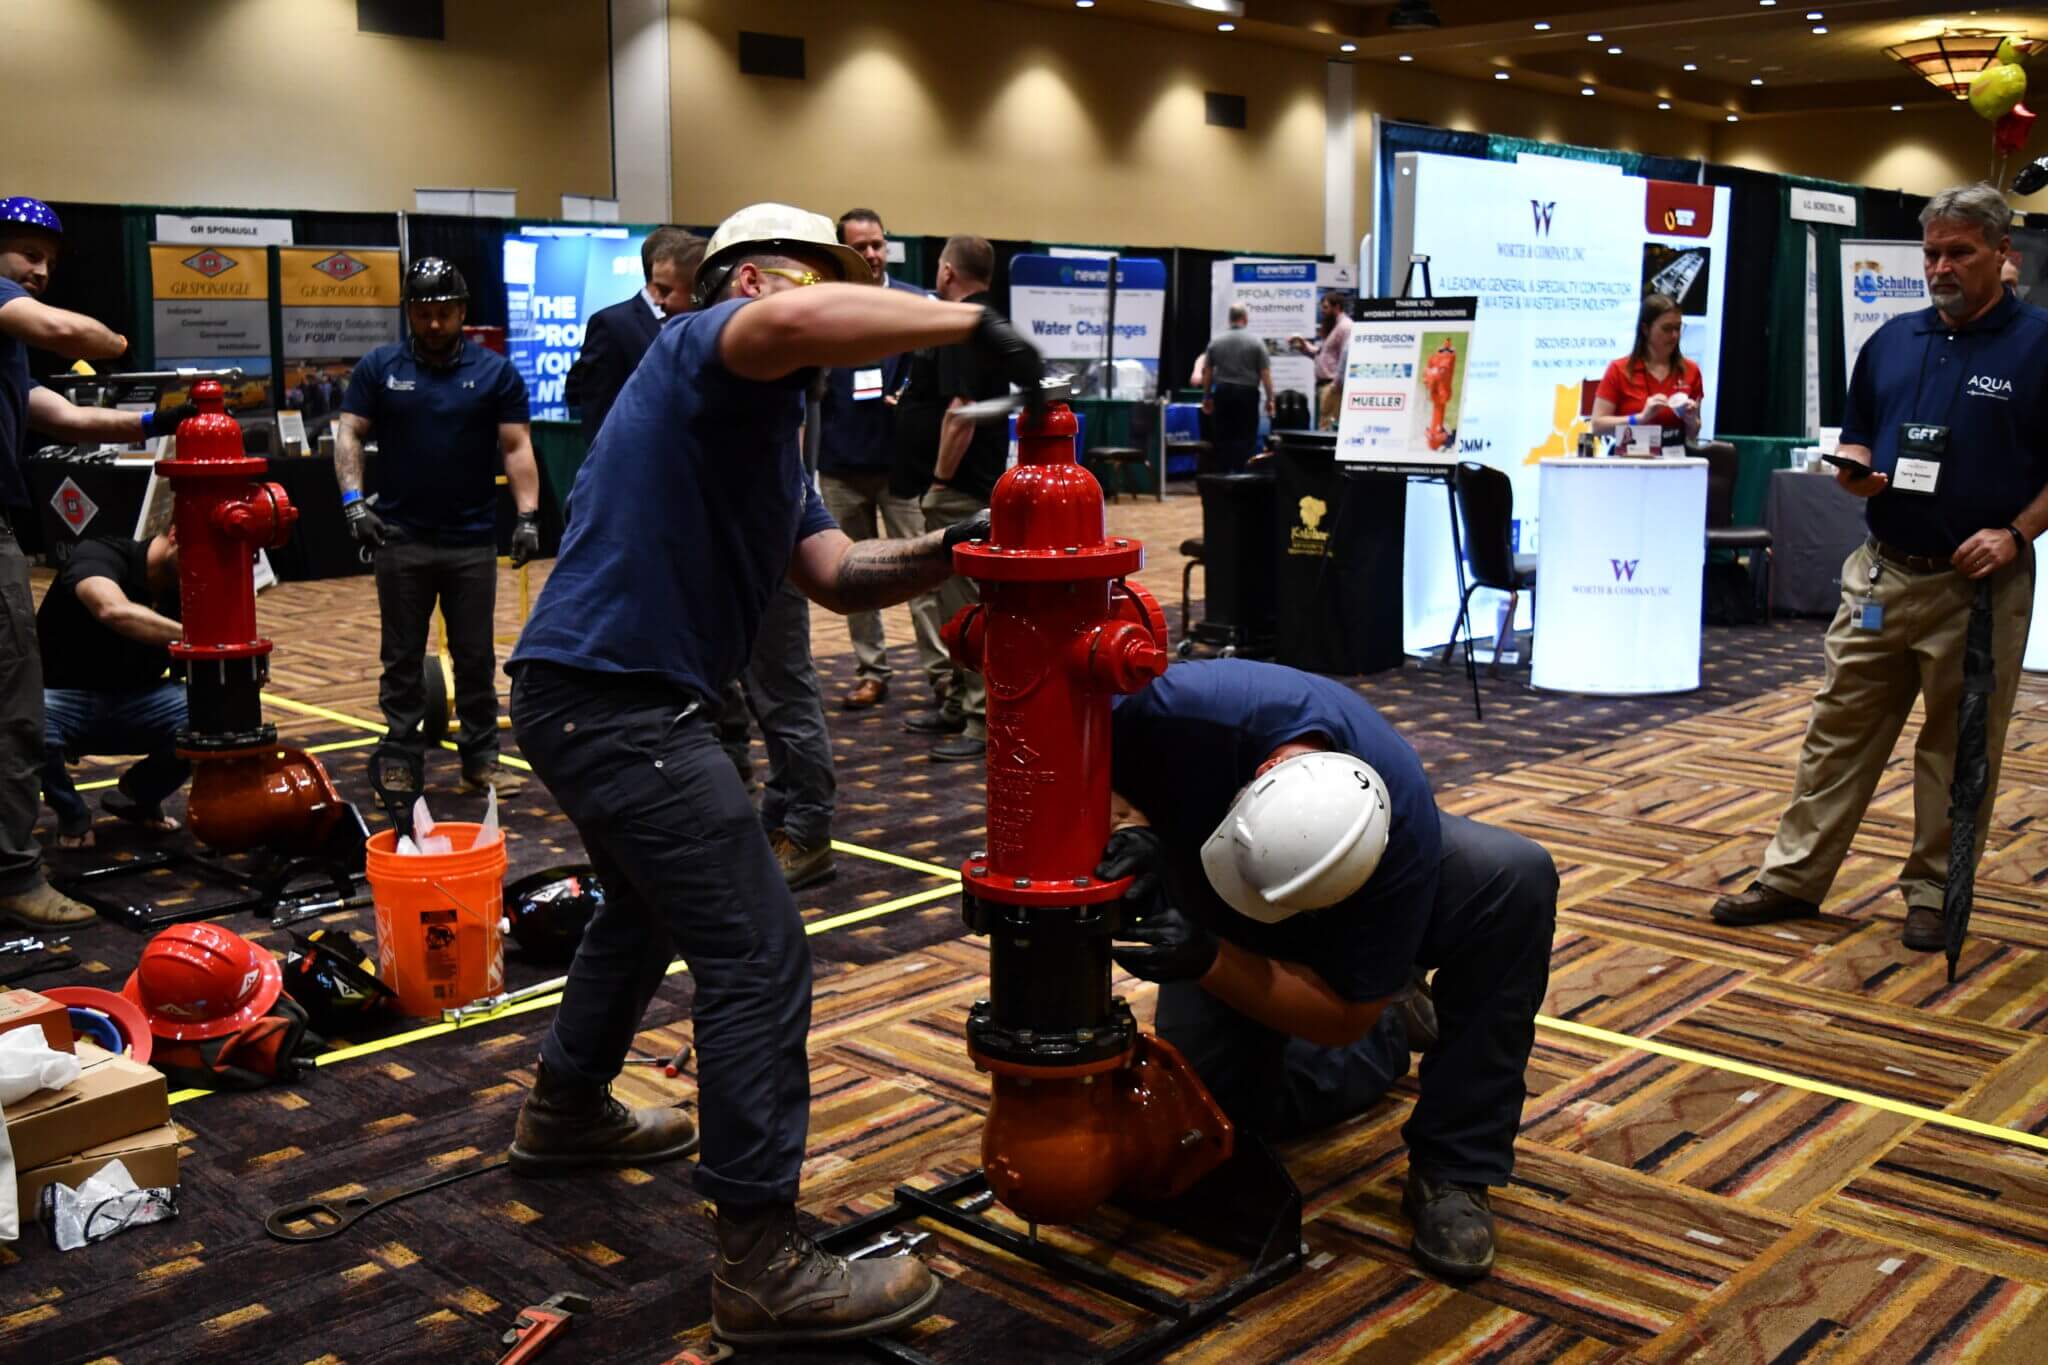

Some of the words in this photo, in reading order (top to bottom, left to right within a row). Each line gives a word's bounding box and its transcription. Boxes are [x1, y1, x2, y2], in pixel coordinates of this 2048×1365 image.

[190, 225, 204, 234] GR
[206, 225, 257, 236] SPONAUGLE
[1447, 276, 1486, 291] LEADING
[1488, 277, 1527, 293] GENERAL
[1877, 275, 1925, 289] Schultes
[1237, 288, 1312, 298] PFOA/PFOS
[534, 296, 577, 319] THE
[1430, 309, 1467, 317] SPONSORS
[1854, 313, 1879, 322] PUMP
[295, 319, 342, 331] Providing
[1031, 320, 1072, 335] Water
[304, 333, 337, 344] FOUR
[1362, 334, 1416, 343] FERGUSON
[1968, 375, 2013, 393] AQUA
[1351, 397, 1402, 407] MUELLER
[1908, 427, 1939, 441] GFT
[1608, 558, 1640, 583] W
[1571, 584, 1605, 595] WORTH
